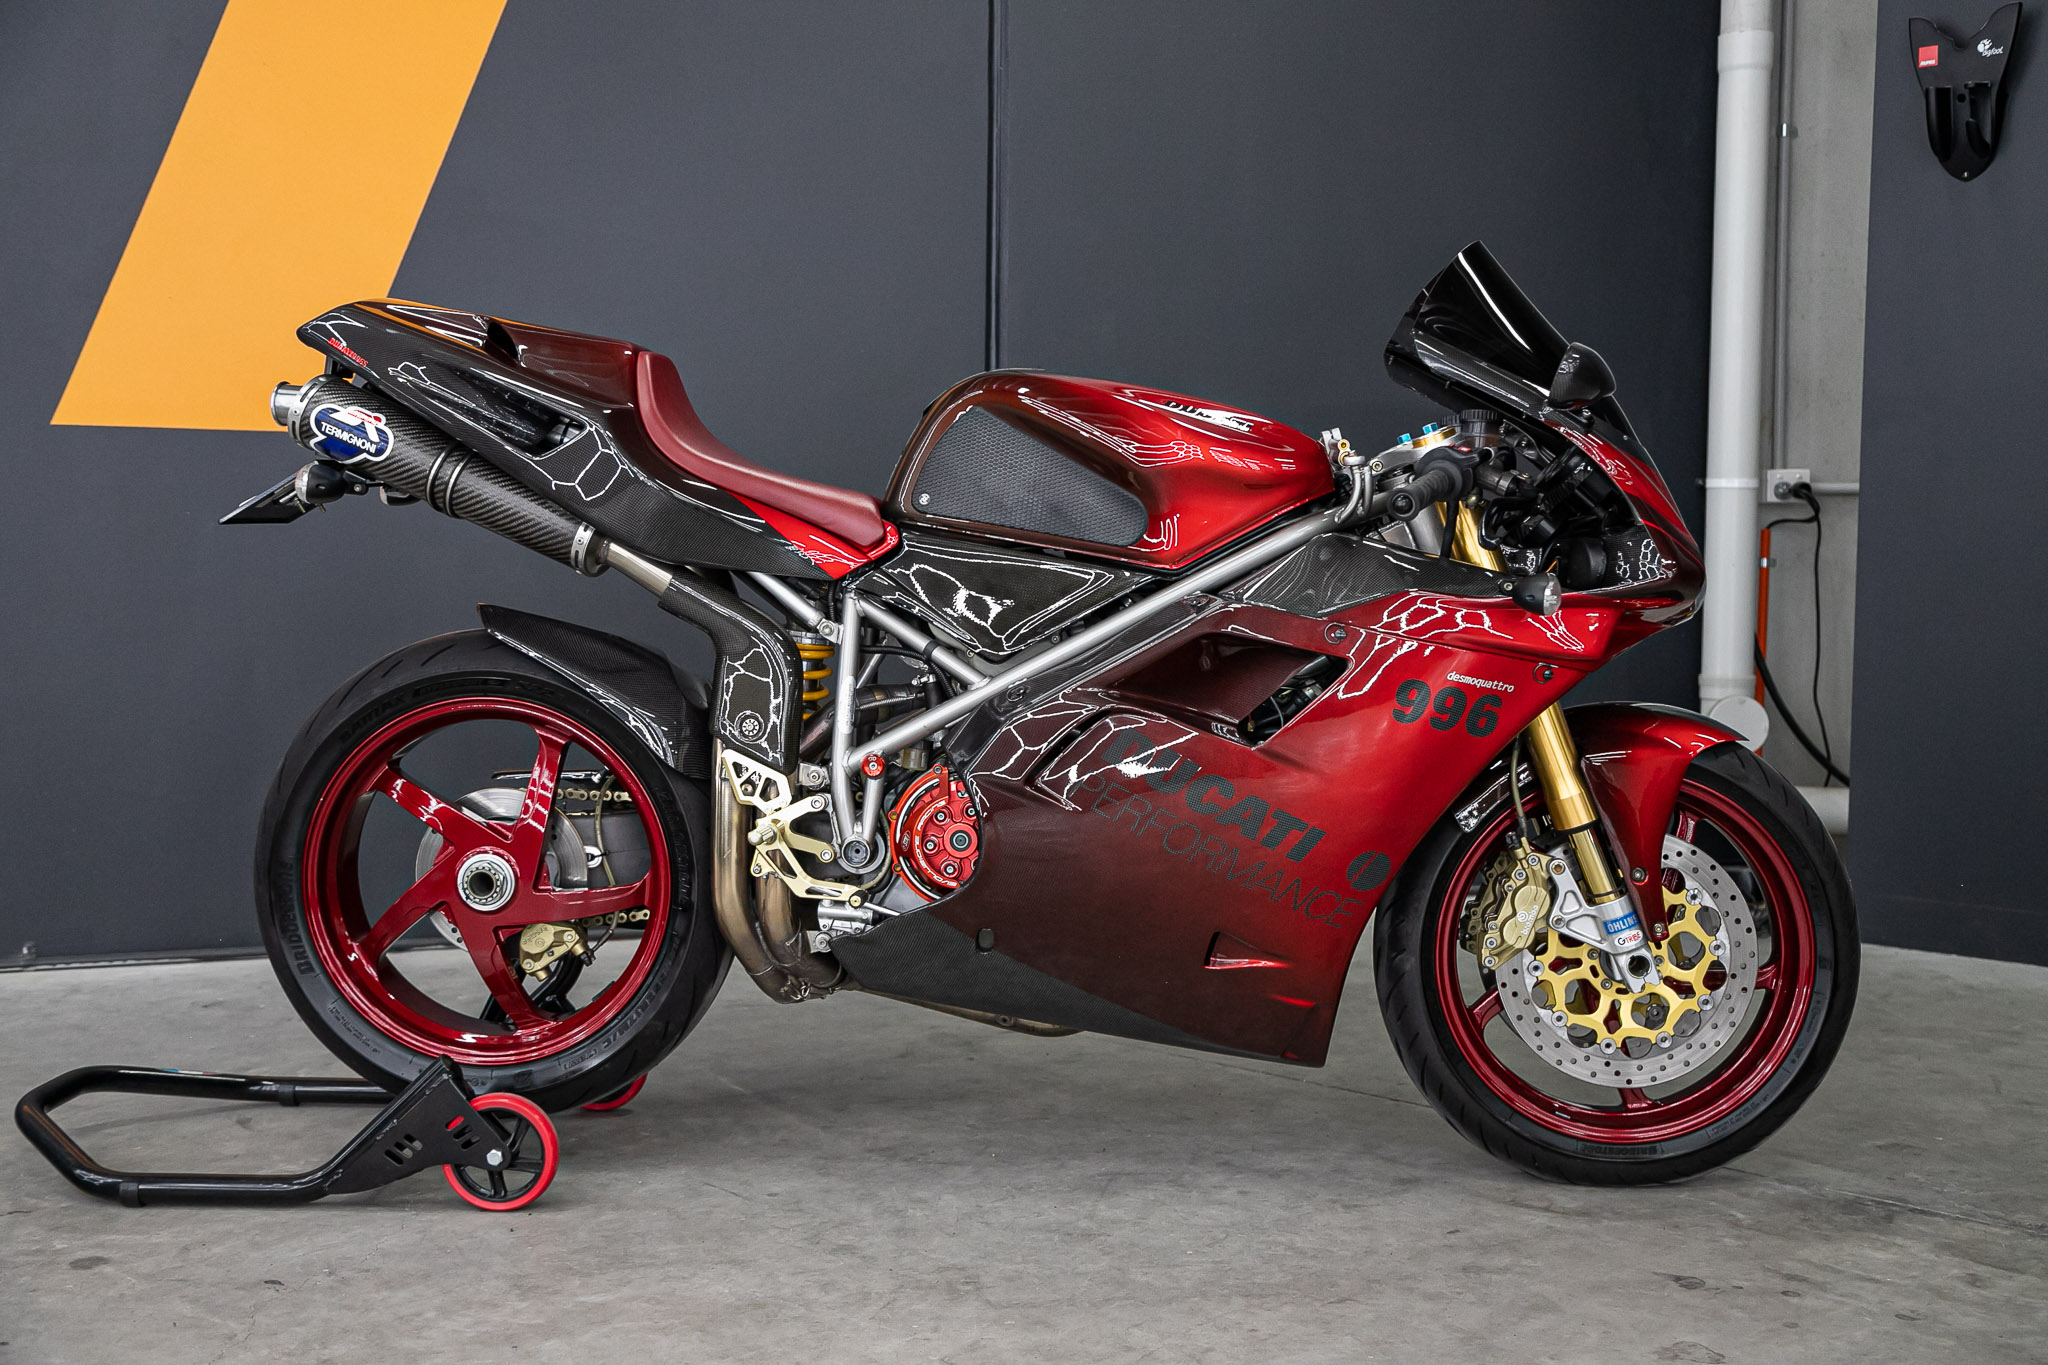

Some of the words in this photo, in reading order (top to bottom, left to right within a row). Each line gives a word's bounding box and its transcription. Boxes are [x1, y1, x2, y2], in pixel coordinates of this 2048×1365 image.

[321, 421, 377, 454] TERMIGNONI
[1447, 671, 1515, 693] desmoquattro
[1392, 678, 1503, 738] 996
[1101, 728, 1326, 863] DUCATI
[1069, 772, 1364, 928] PERFORMANCE
[1520, 905, 1539, 936] brembo
